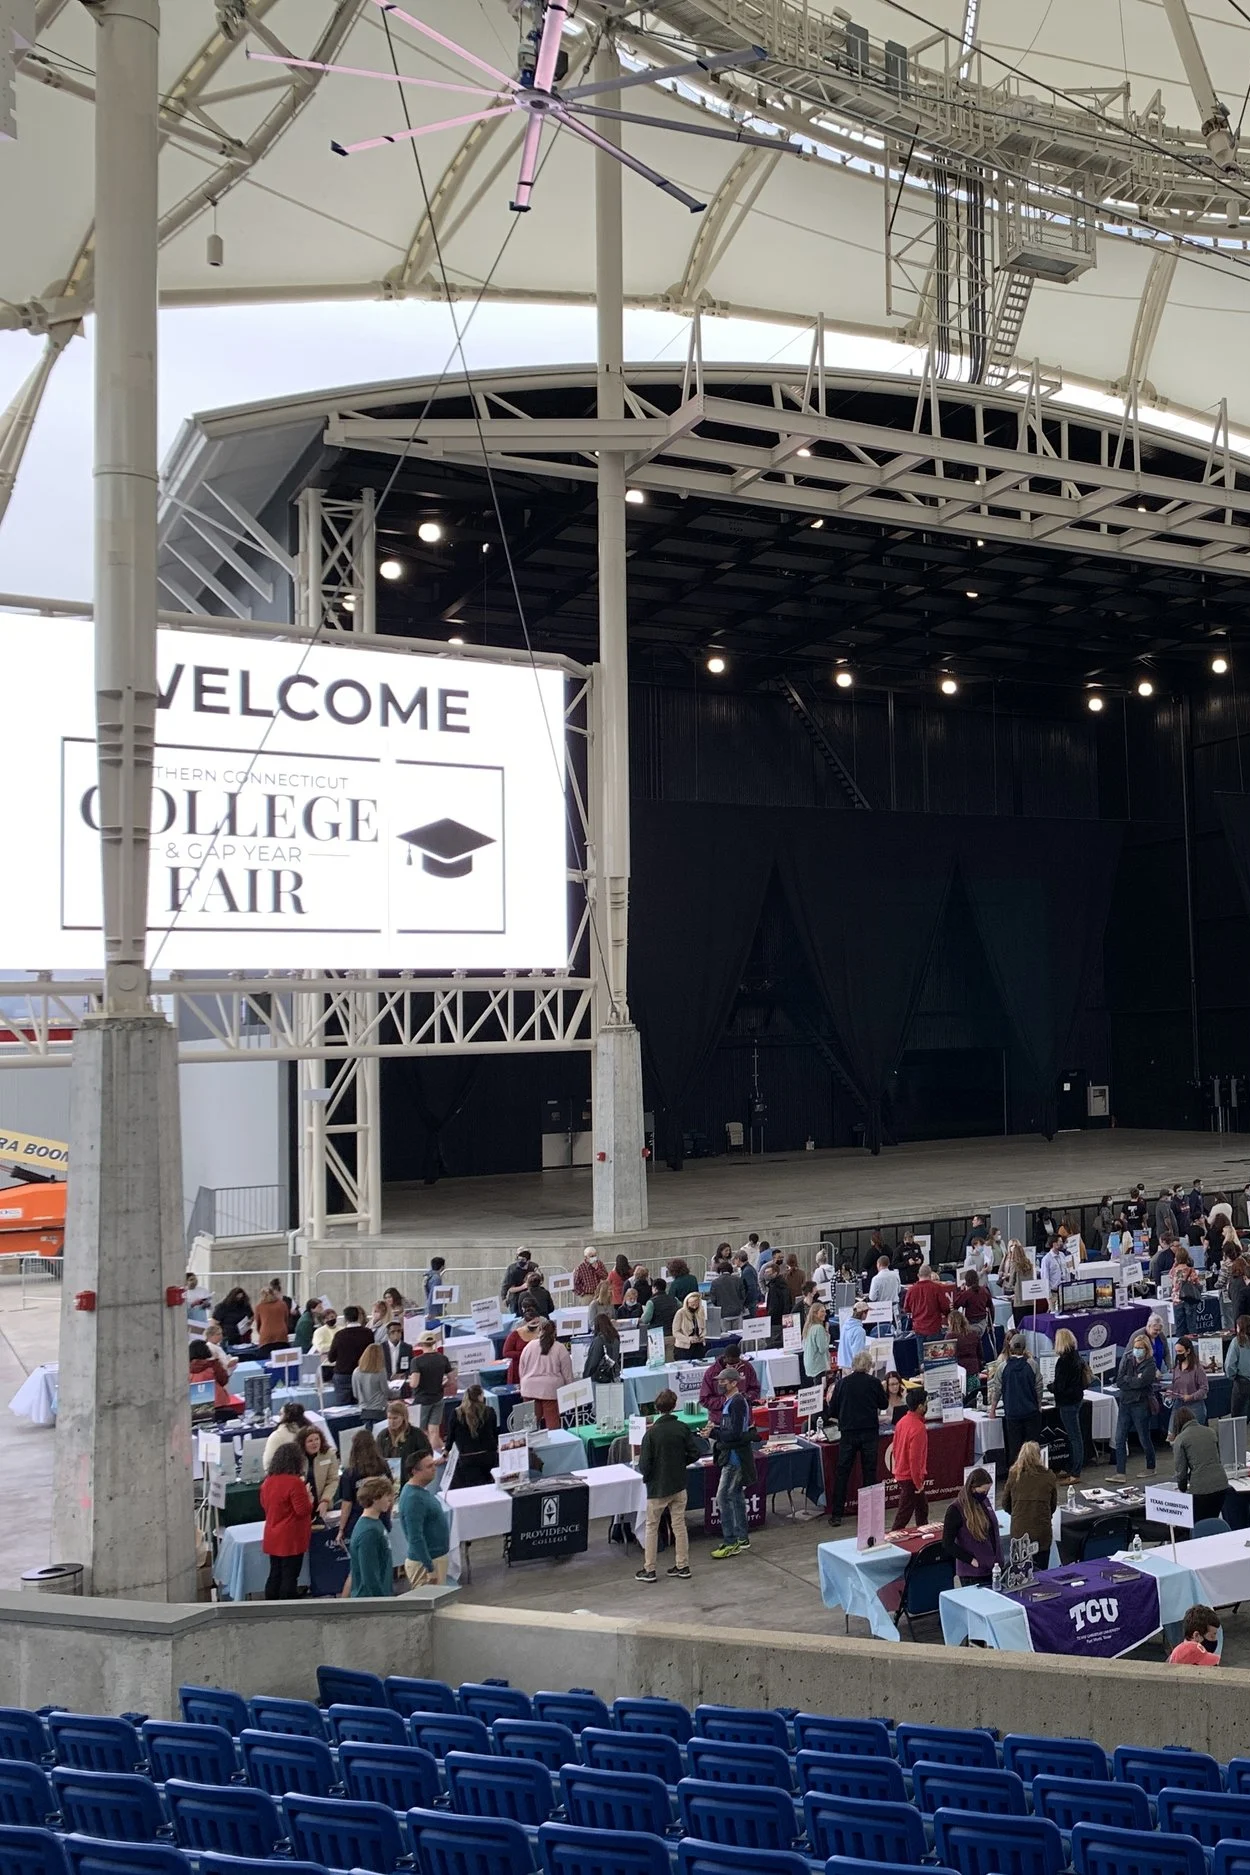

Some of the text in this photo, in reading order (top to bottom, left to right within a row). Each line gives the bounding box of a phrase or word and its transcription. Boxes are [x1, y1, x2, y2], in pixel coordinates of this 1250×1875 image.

[152, 766, 349, 790] THERN CONNECTICUT
[187, 842, 236, 860] GAP
[243, 844, 302, 863] YEAR
[165, 866, 309, 915] FAIR
[1149, 1498, 1189, 1510] TEXAS CHRISTIAN
[1156, 1507, 1183, 1515] UNIVERSITY
[520, 1523, 580, 1541] PROVIDENCE
[531, 1535, 567, 1546] COLLEGE
[1069, 1597, 1119, 1632] TCU
